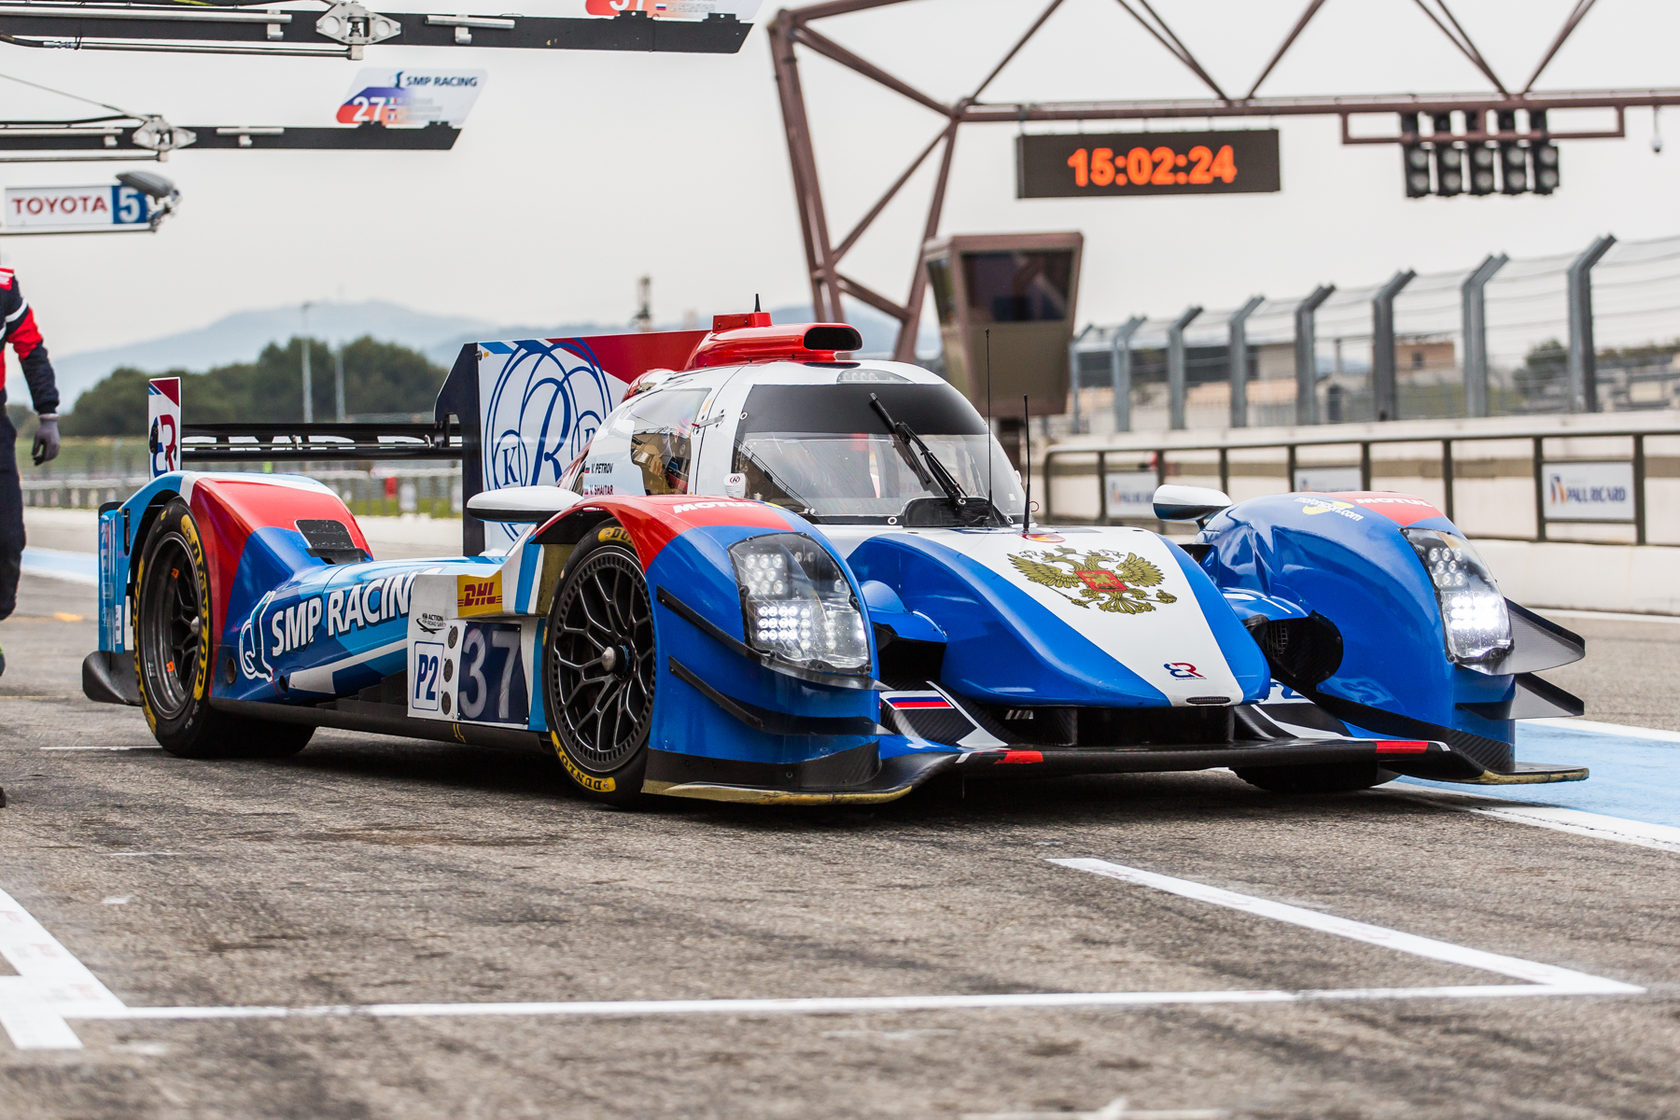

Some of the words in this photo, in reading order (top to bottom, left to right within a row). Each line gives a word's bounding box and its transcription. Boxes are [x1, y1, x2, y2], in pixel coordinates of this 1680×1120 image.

[406, 76, 432, 87] SMP
[433, 76, 478, 87] RACING
[352, 96, 386, 122] 27
[1067, 145, 1238, 187] 15:02:24
[12, 197, 109, 215] TOYOTA
[118, 187, 140, 223] 5
[595, 463, 614, 474] PETROV
[1354, 497, 1433, 508] MOTUL
[1590, 485, 1627, 503] RICARD
[673, 501, 760, 514] MOTUL
[464, 582, 497, 607] DHL
[271, 597, 323, 657] SMP
[327, 571, 416, 637] RACIN
[415, 653, 439, 701] P2
[458, 627, 522, 720] 37
